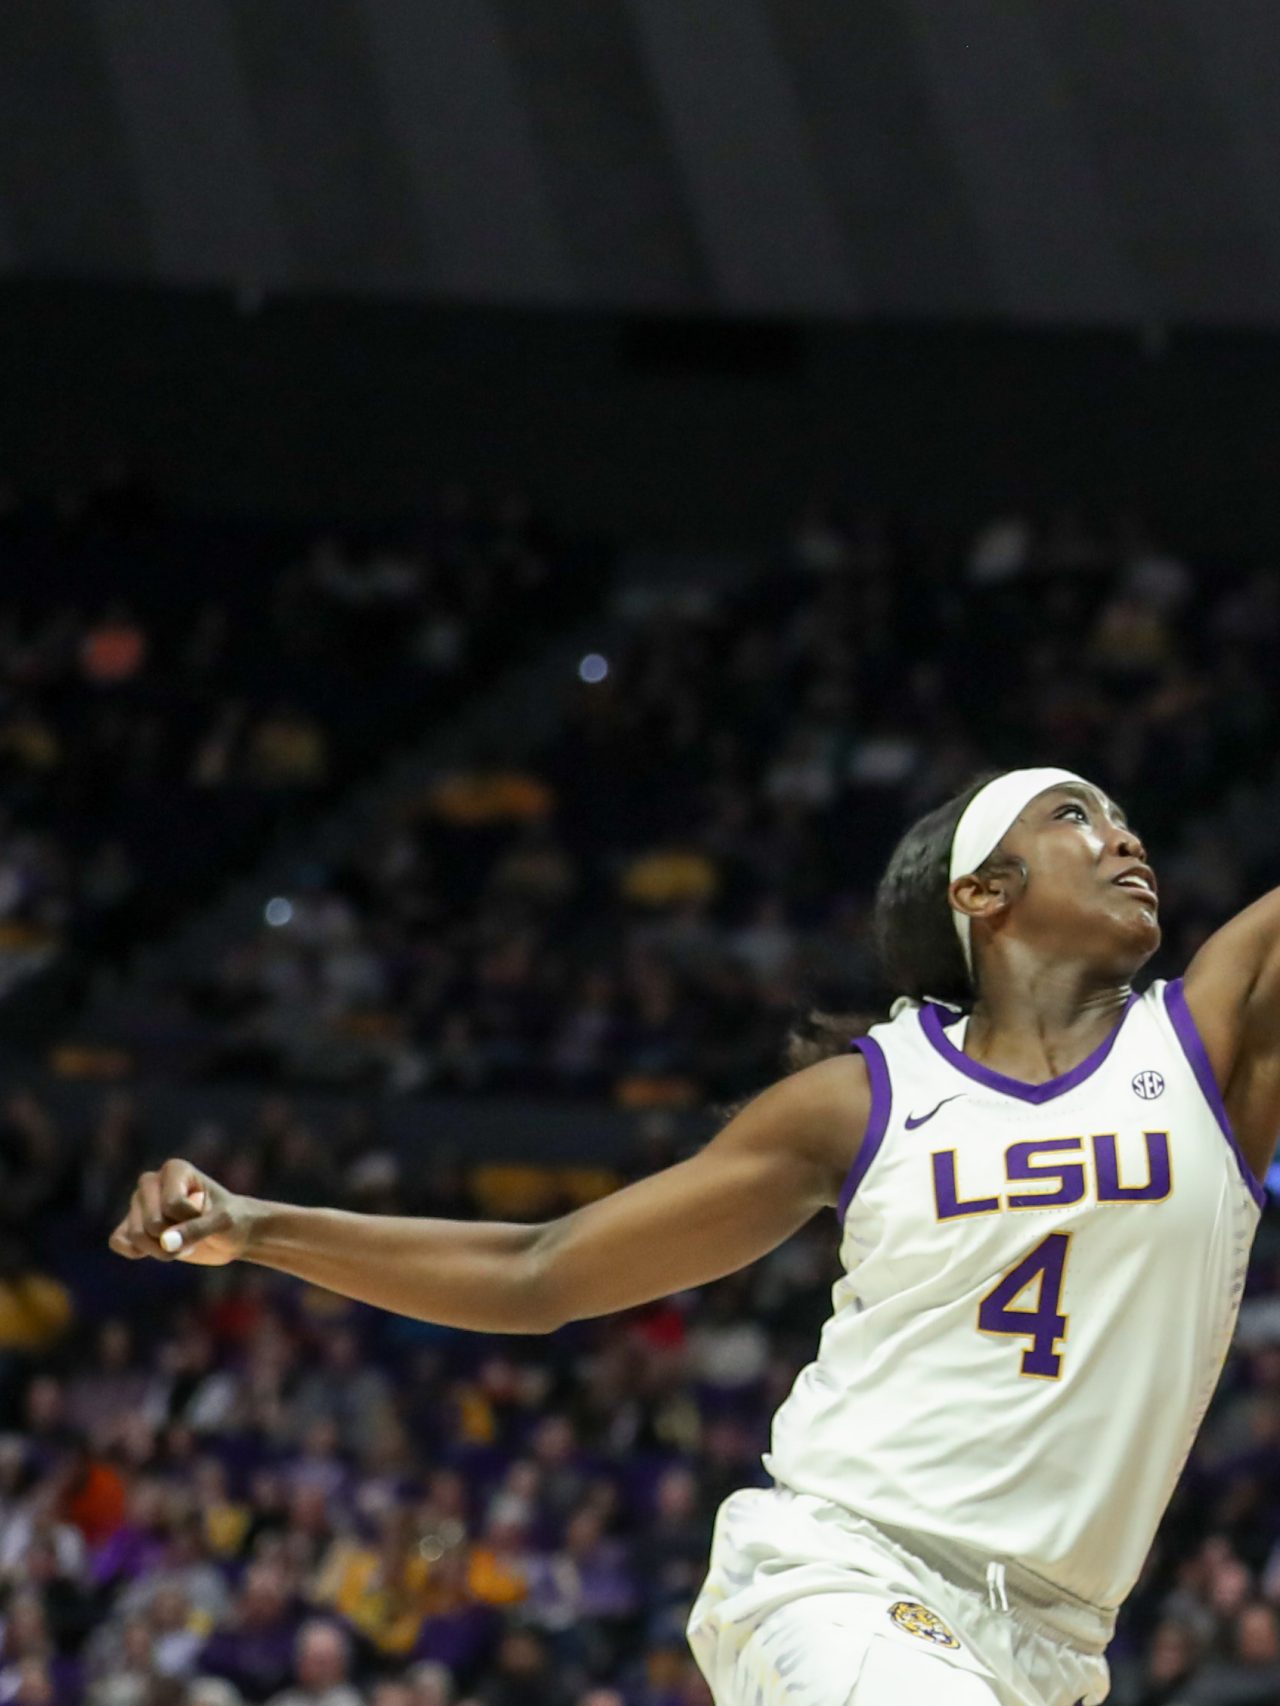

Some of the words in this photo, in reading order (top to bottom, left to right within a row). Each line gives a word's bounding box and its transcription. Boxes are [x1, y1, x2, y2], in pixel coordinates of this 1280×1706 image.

[1132, 1071, 1165, 1099] SEC
[930, 1130, 1175, 1224] LSU
[976, 1230, 1074, 1382] 4
